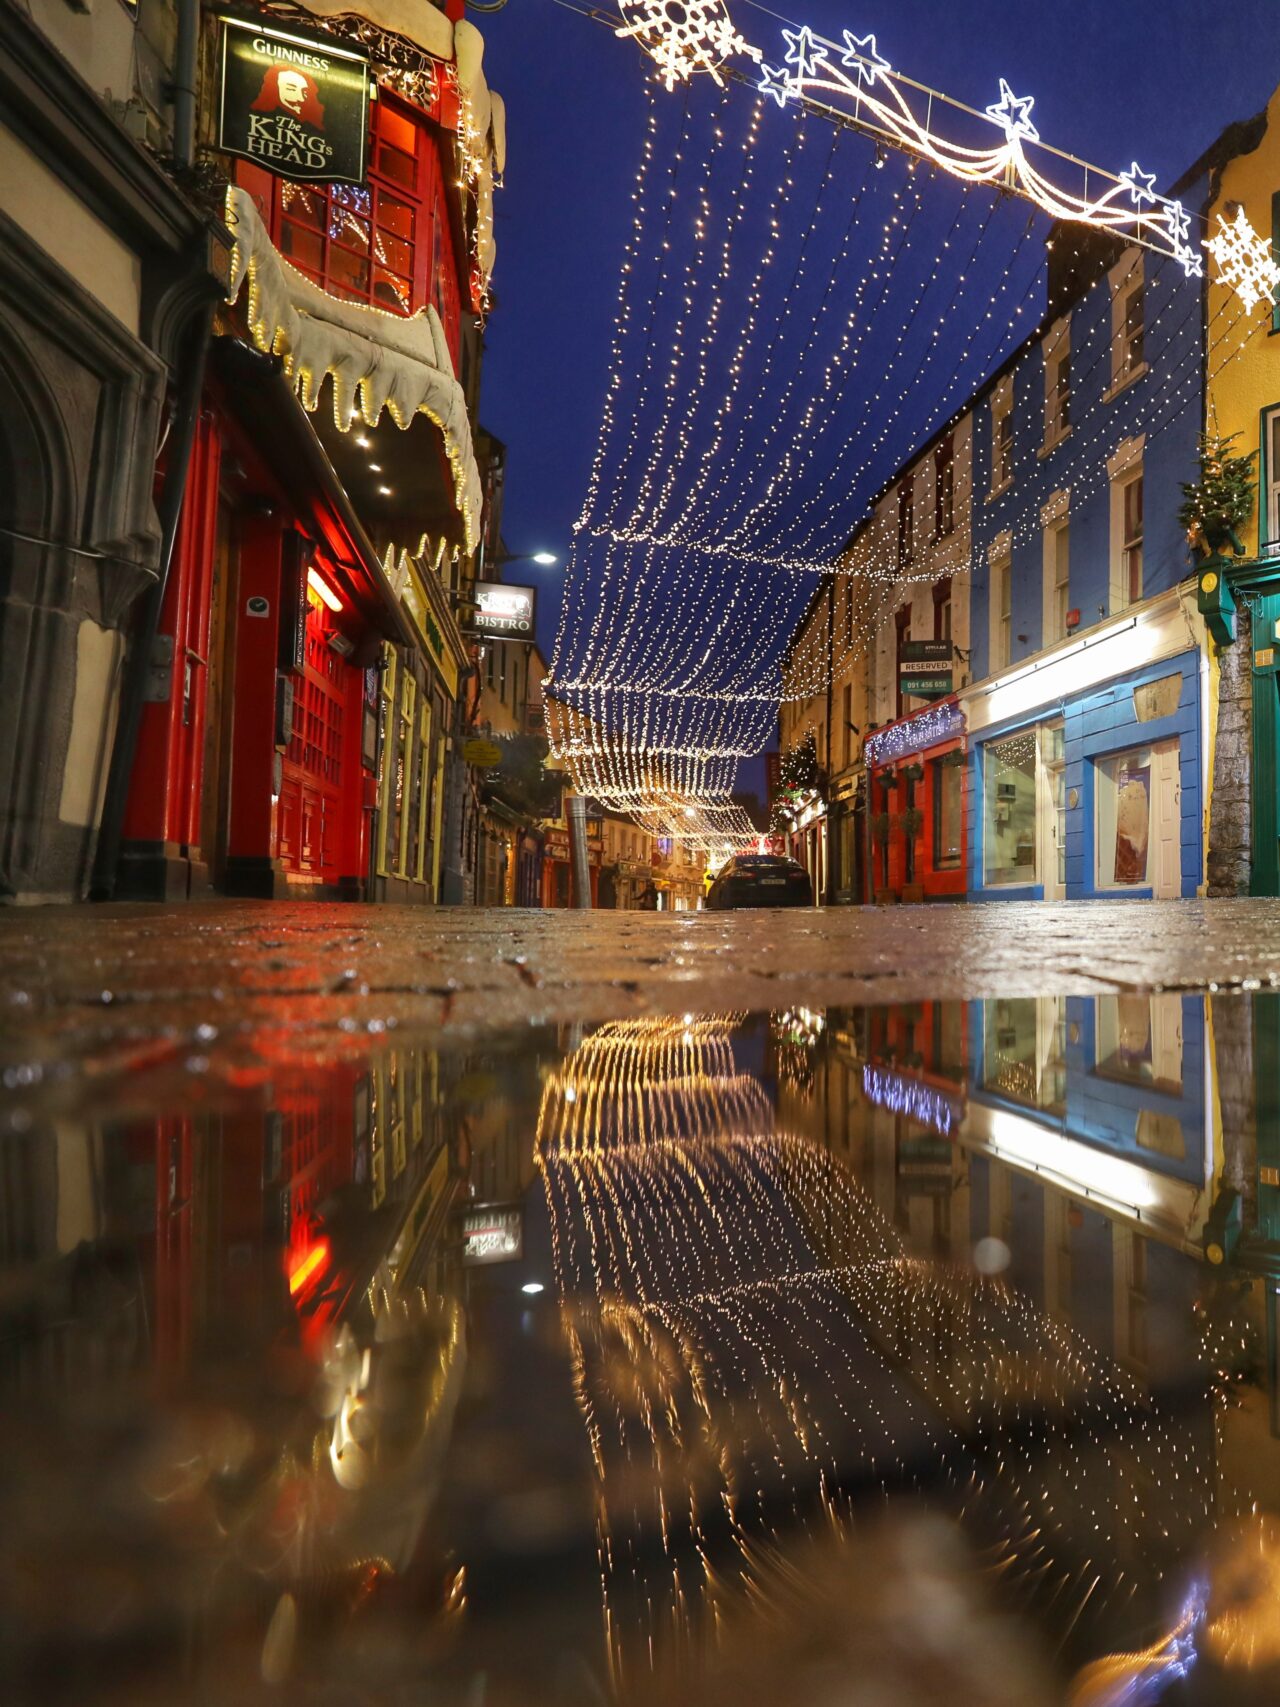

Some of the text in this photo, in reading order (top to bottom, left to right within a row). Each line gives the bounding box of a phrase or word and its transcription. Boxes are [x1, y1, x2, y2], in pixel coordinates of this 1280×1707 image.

[252, 37, 330, 72] GUINNESS
[275, 114, 303, 132] The
[245, 134, 327, 169] HEAD
[474, 615, 530, 631] BISTRO
[905, 661, 949, 671] RESERVED
[907, 681, 920, 689] 091
